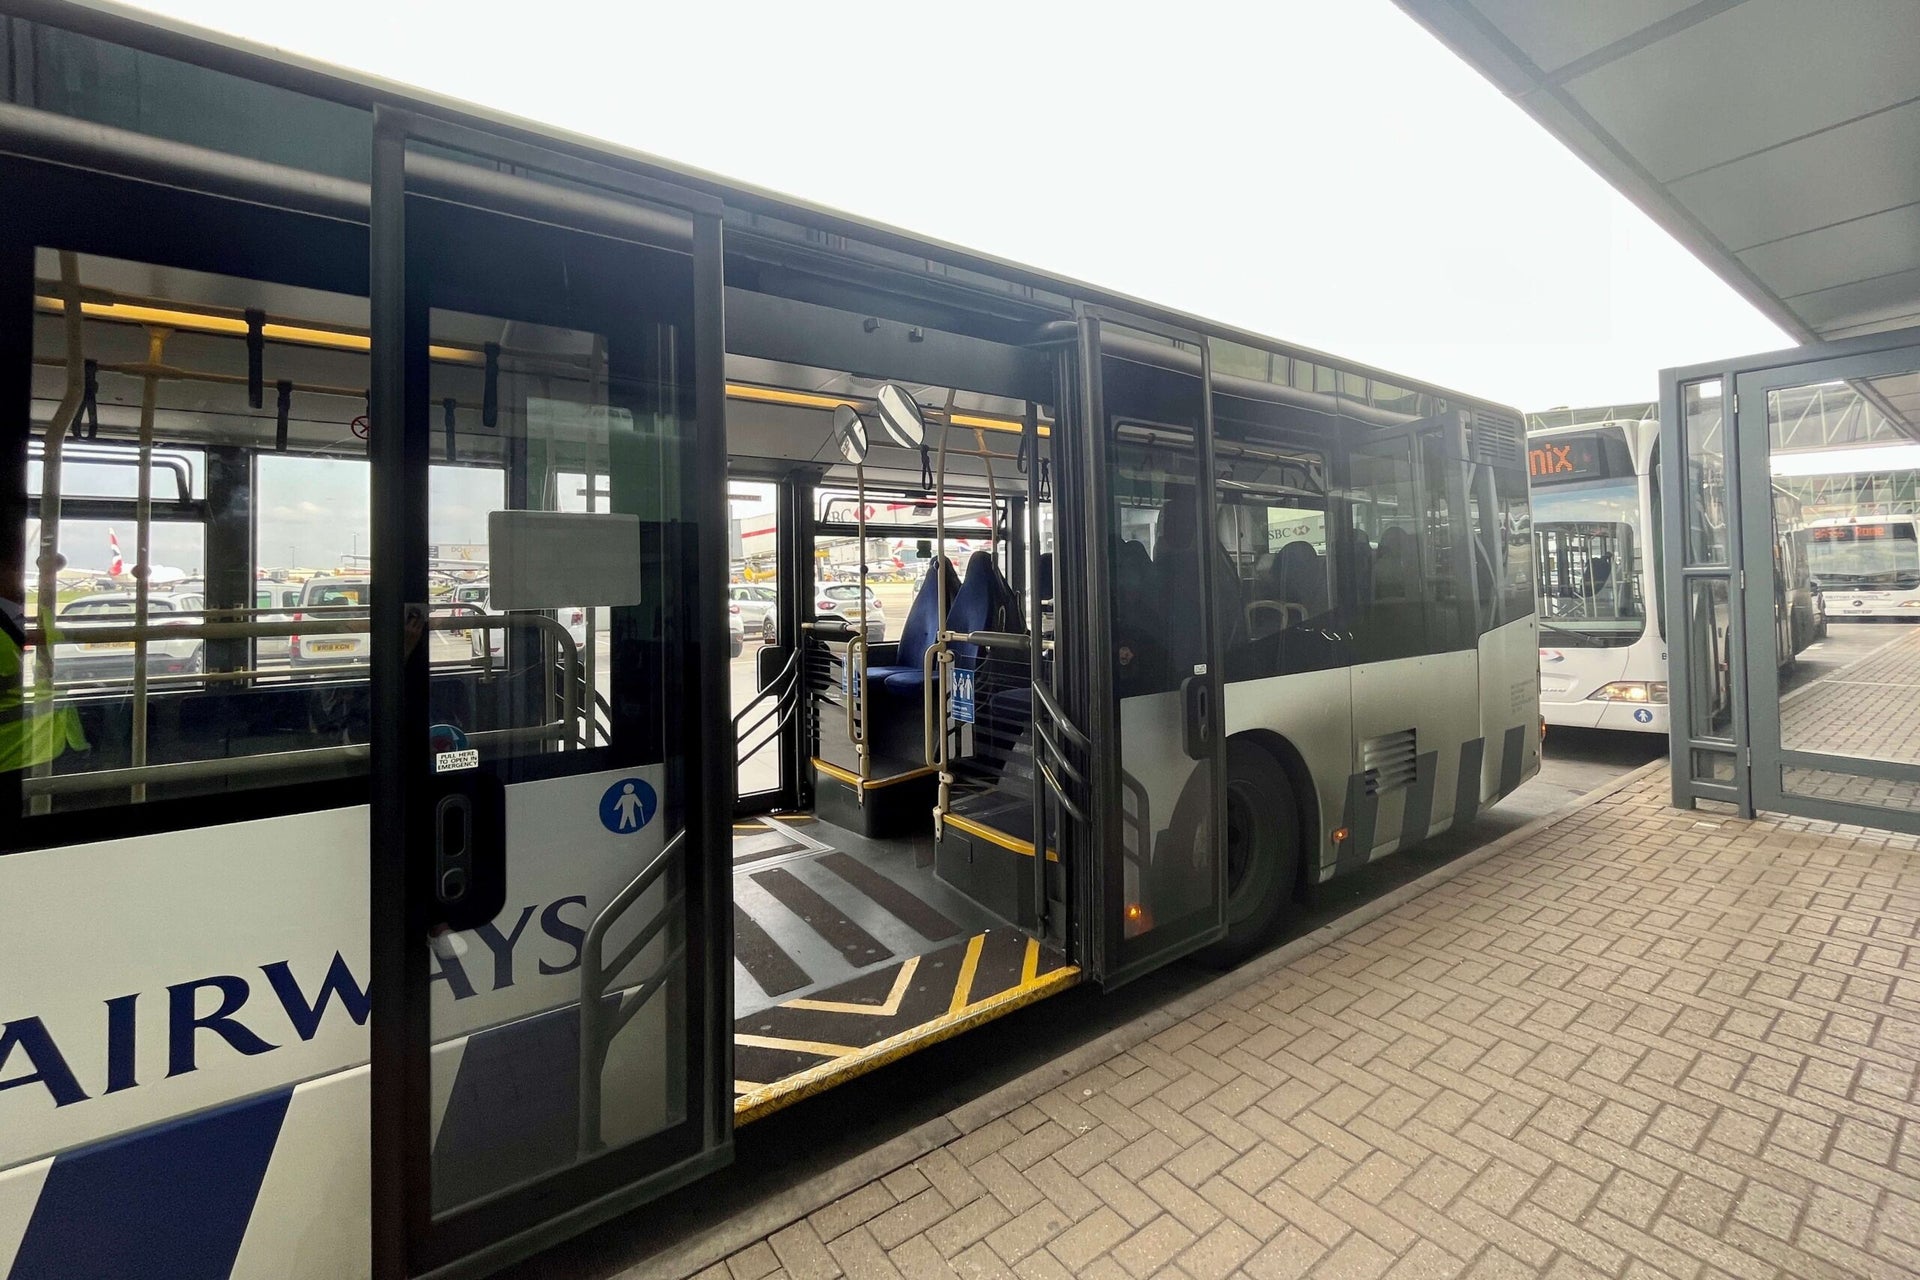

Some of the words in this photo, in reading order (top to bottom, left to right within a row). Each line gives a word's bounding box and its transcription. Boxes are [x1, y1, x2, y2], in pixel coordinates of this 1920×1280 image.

[1529, 443, 1573, 476] nix
[831, 508, 852, 522] BC
[1268, 527, 1292, 540] SBC
[438, 761, 478, 770] EMERGENCY
[0, 895, 587, 1108] AIRWAYS
